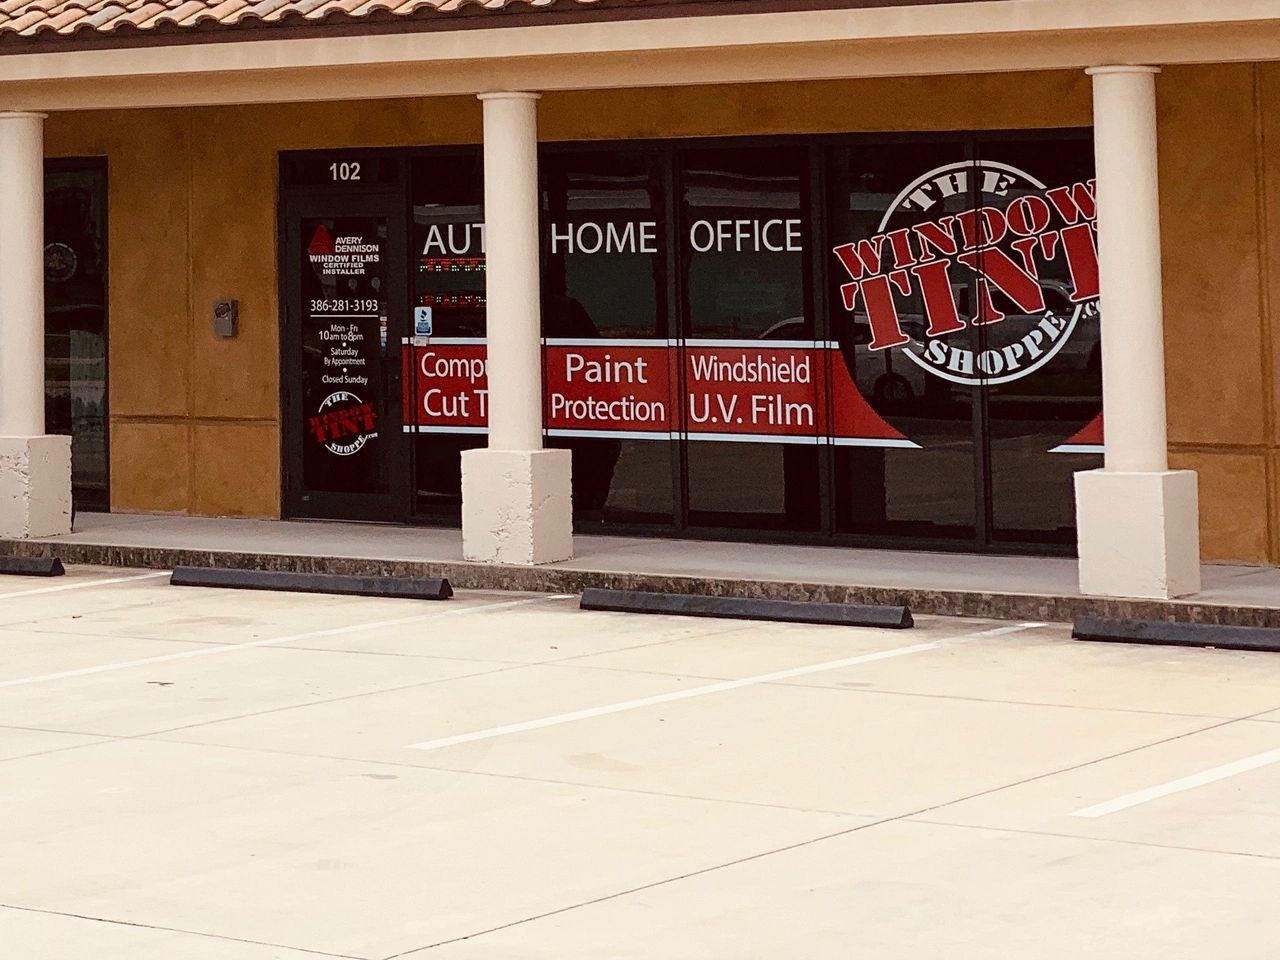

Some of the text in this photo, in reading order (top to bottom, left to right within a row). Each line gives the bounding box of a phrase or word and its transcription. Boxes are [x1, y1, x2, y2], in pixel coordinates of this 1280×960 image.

[329, 162, 361, 181] 102
[902, 171, 1017, 212] THE
[335, 236, 363, 244] AVERY
[422, 219, 803, 255] AUT HOME OFFICE
[833, 178, 1098, 281] WINDOW
[309, 254, 380, 263] WINDOW FILMS
[335, 244, 379, 253] DENNISON
[840, 222, 1100, 351] TINT
[310, 300, 379, 311] 386-281-3193
[330, 324, 346, 332] Mon
[923, 310, 1067, 375] SHOPPE
[323, 356, 366, 366] By Appointment
[330, 347, 359, 357] Saturday
[321, 374, 369, 385] Closed Sunday
[421, 352, 488, 384] Comp
[566, 353, 648, 384] Paint
[691, 354, 811, 384] Windshield
[324, 393, 349, 407] THE
[423, 388, 469, 417] Cut
[551, 393, 665, 422] Protection
[689, 393, 814, 426] U.V. Film
[311, 413, 378, 442] TINT
[331, 435, 365, 453] SHOPPE
